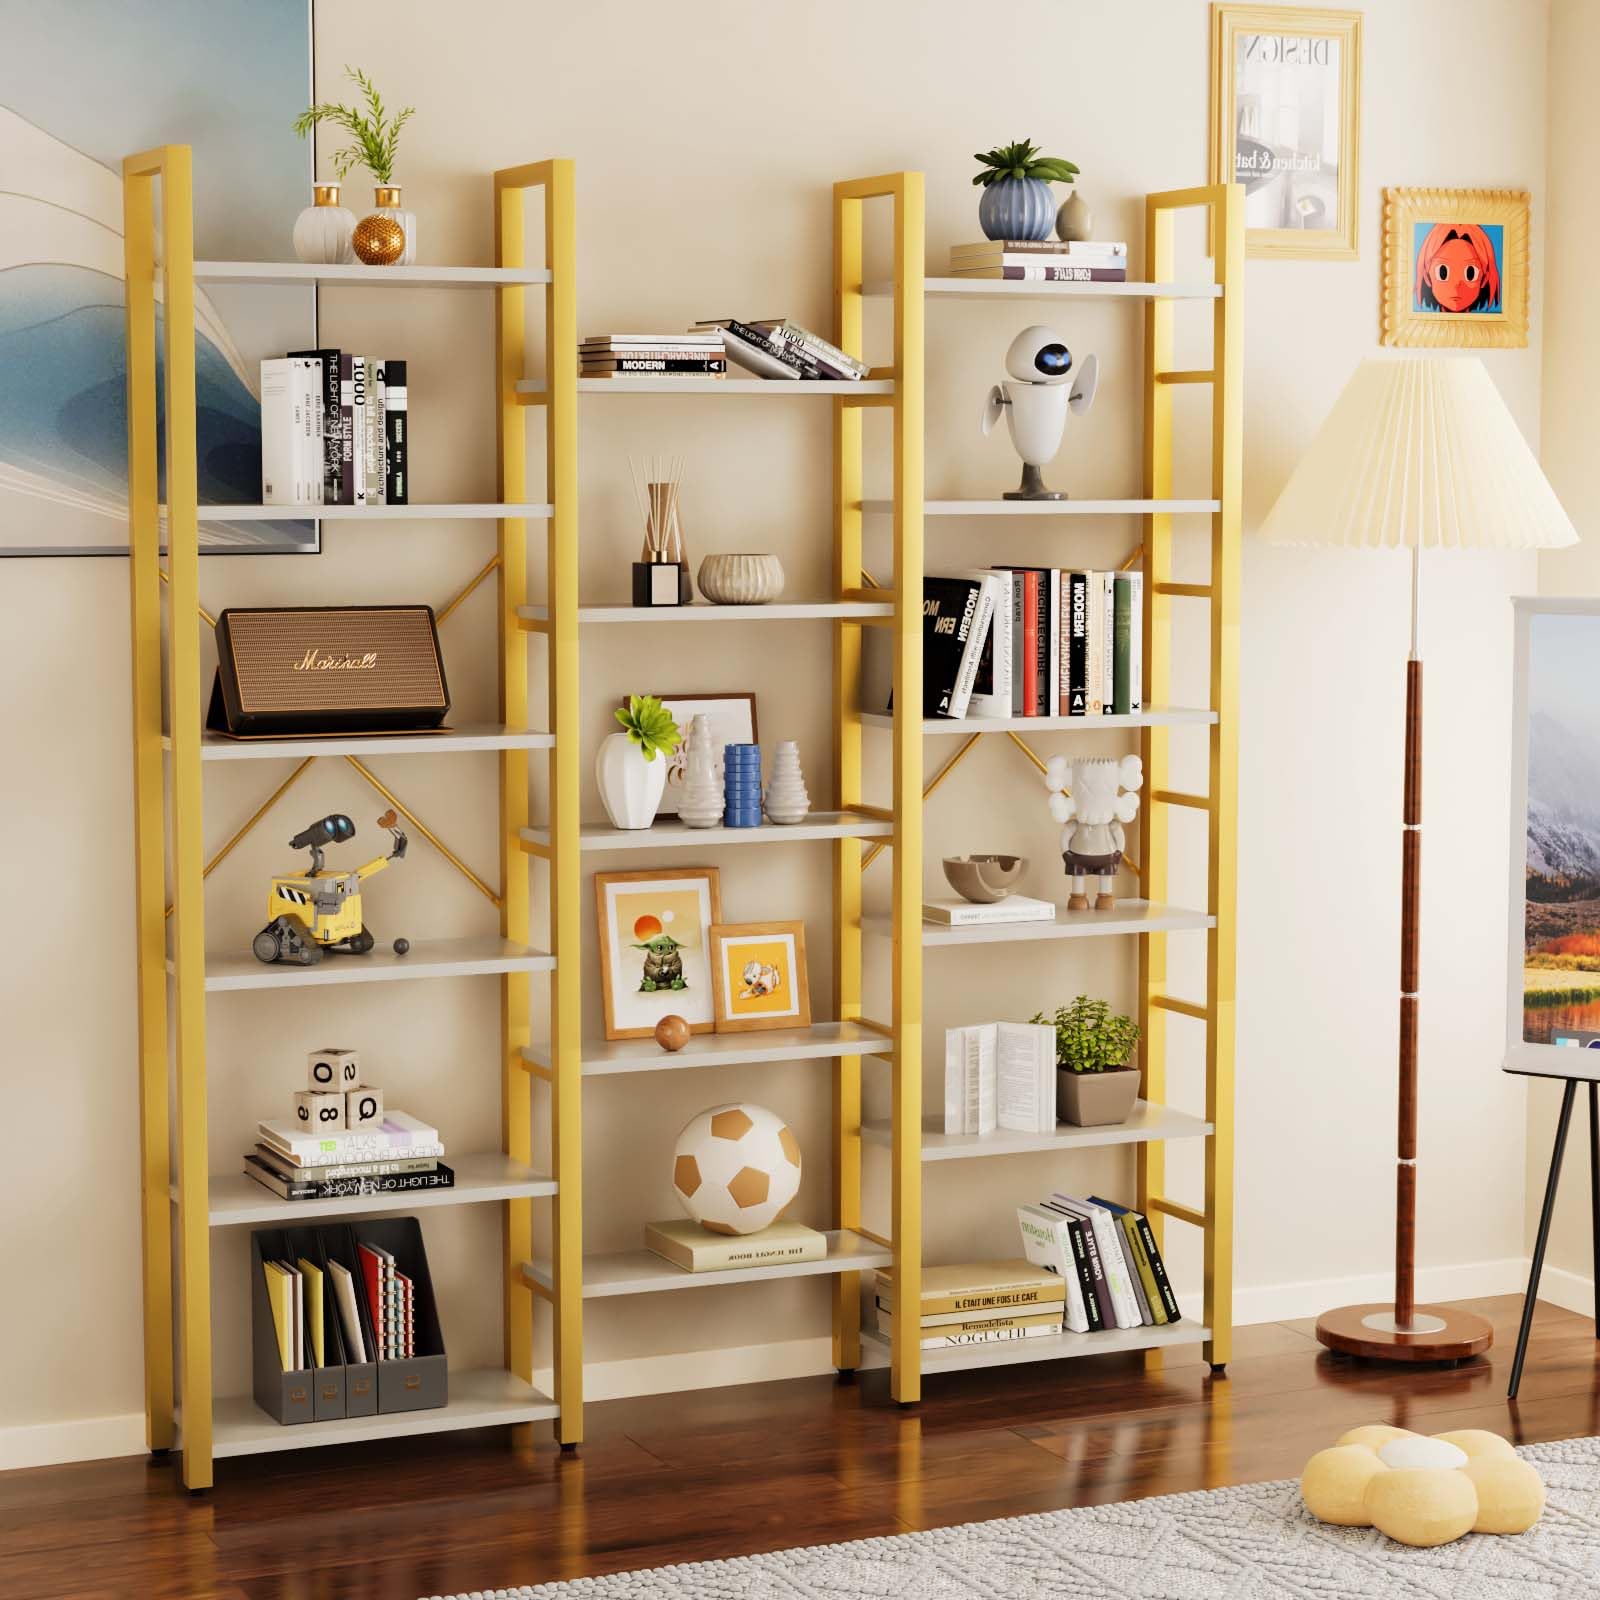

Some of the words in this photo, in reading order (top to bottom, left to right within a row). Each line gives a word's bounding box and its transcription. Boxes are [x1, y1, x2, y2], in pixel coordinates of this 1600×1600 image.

[779, 328, 805, 348] 1000
[330, 354, 338, 374] THE
[622, 360, 666, 370] MODERN
[330, 375, 338, 404] LIGHT
[354, 362, 365, 406] 1000
[330, 405, 338, 419] OF
[377, 398, 386, 426] design
[330, 420, 338, 443] NEW
[343, 416, 352, 439] STYLE
[343, 440, 352, 462] FORM
[377, 446, 385, 496] Architecture
[294, 649, 377, 671] Marshall
[314, 1062, 332, 1083] O
[323, 1182, 354, 1194] YORK
[354, 1179, 380, 1191] NEW
[380, 1178, 397, 1188] OF
[398, 1176, 428, 1187] LIGHT
[429, 1174, 450, 1184] THE
[955, 1301, 962, 1309] IL
[982, 1296, 996, 1306] UNE
[996, 1295, 1011, 1304] FOIS
[1012, 1294, 1020, 1303] LE
[962, 1319, 1014, 1331] Remodelista
[945, 1328, 1026, 1347] NOGUCHI
